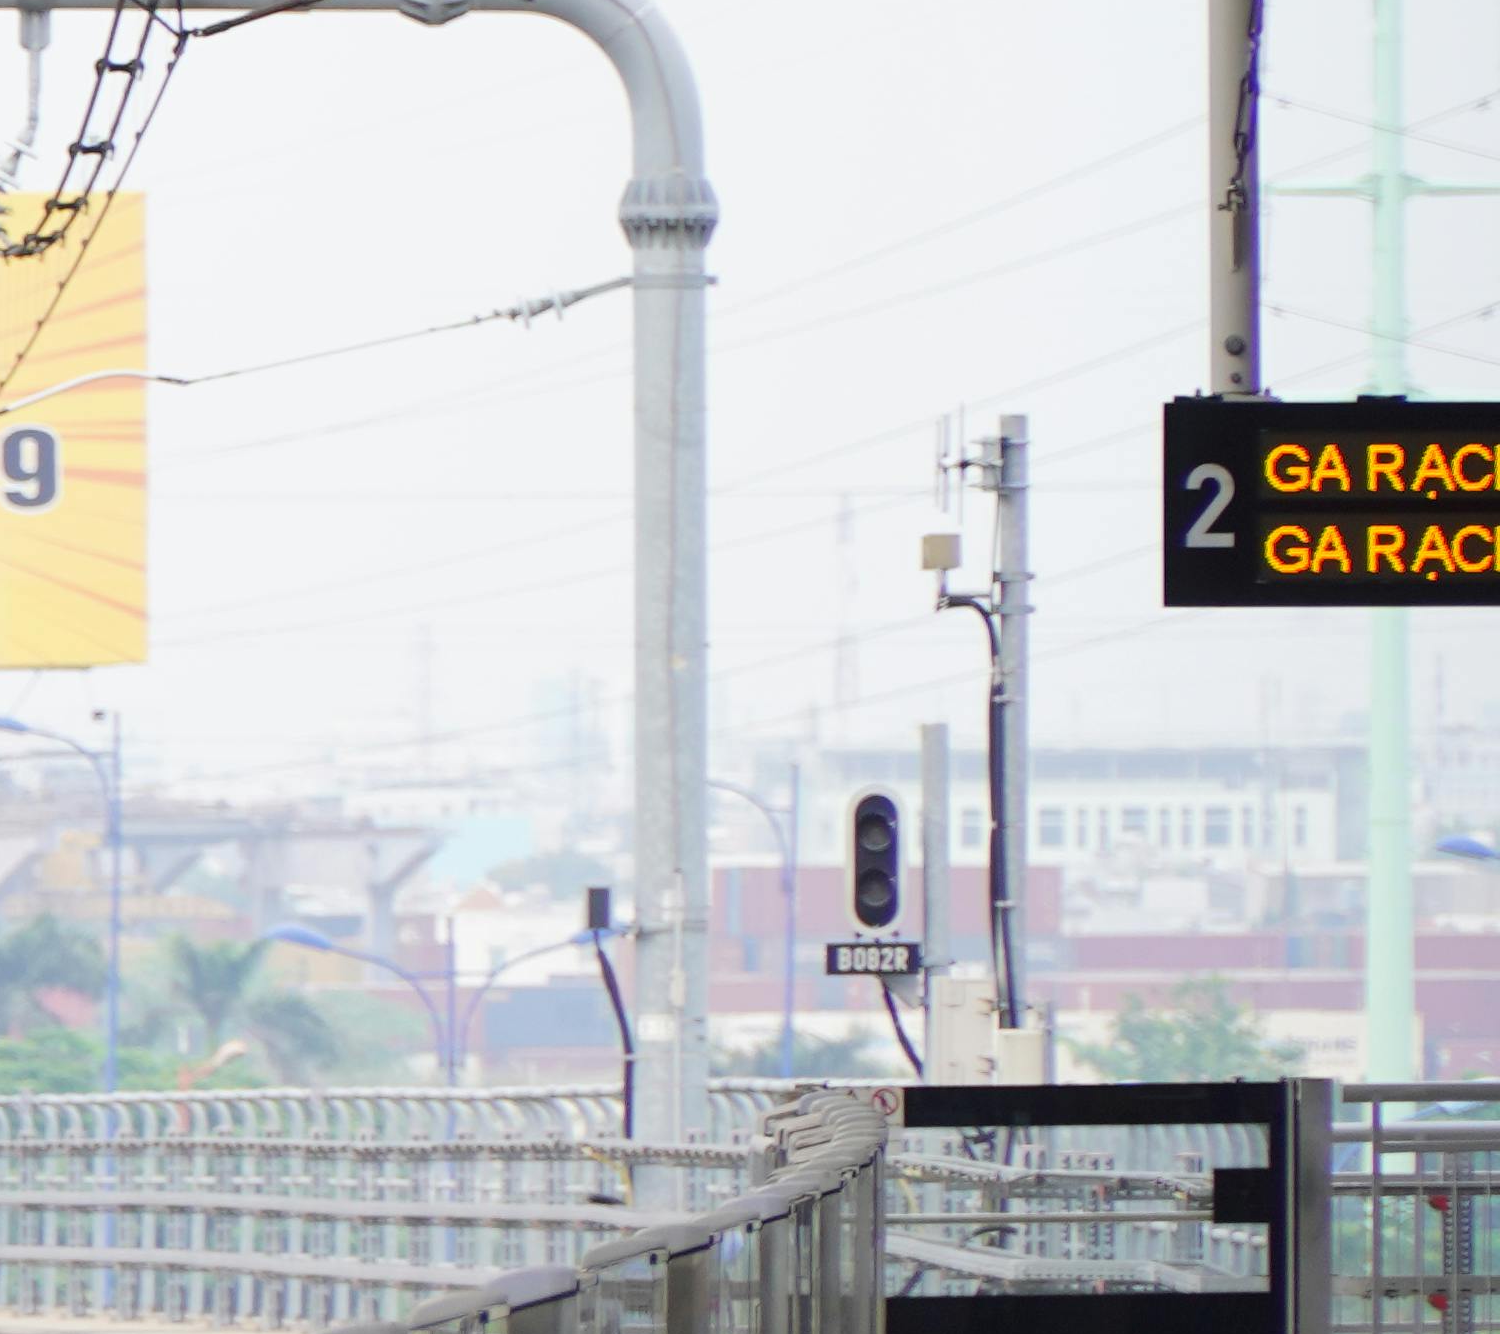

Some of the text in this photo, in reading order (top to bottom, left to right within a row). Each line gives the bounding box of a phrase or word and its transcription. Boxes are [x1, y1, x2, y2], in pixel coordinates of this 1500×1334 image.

[1264, 443, 1500, 500] GA RẠC
[1185, 463, 1235, 548] 2
[1264, 525, 1500, 581] GA RẠC
